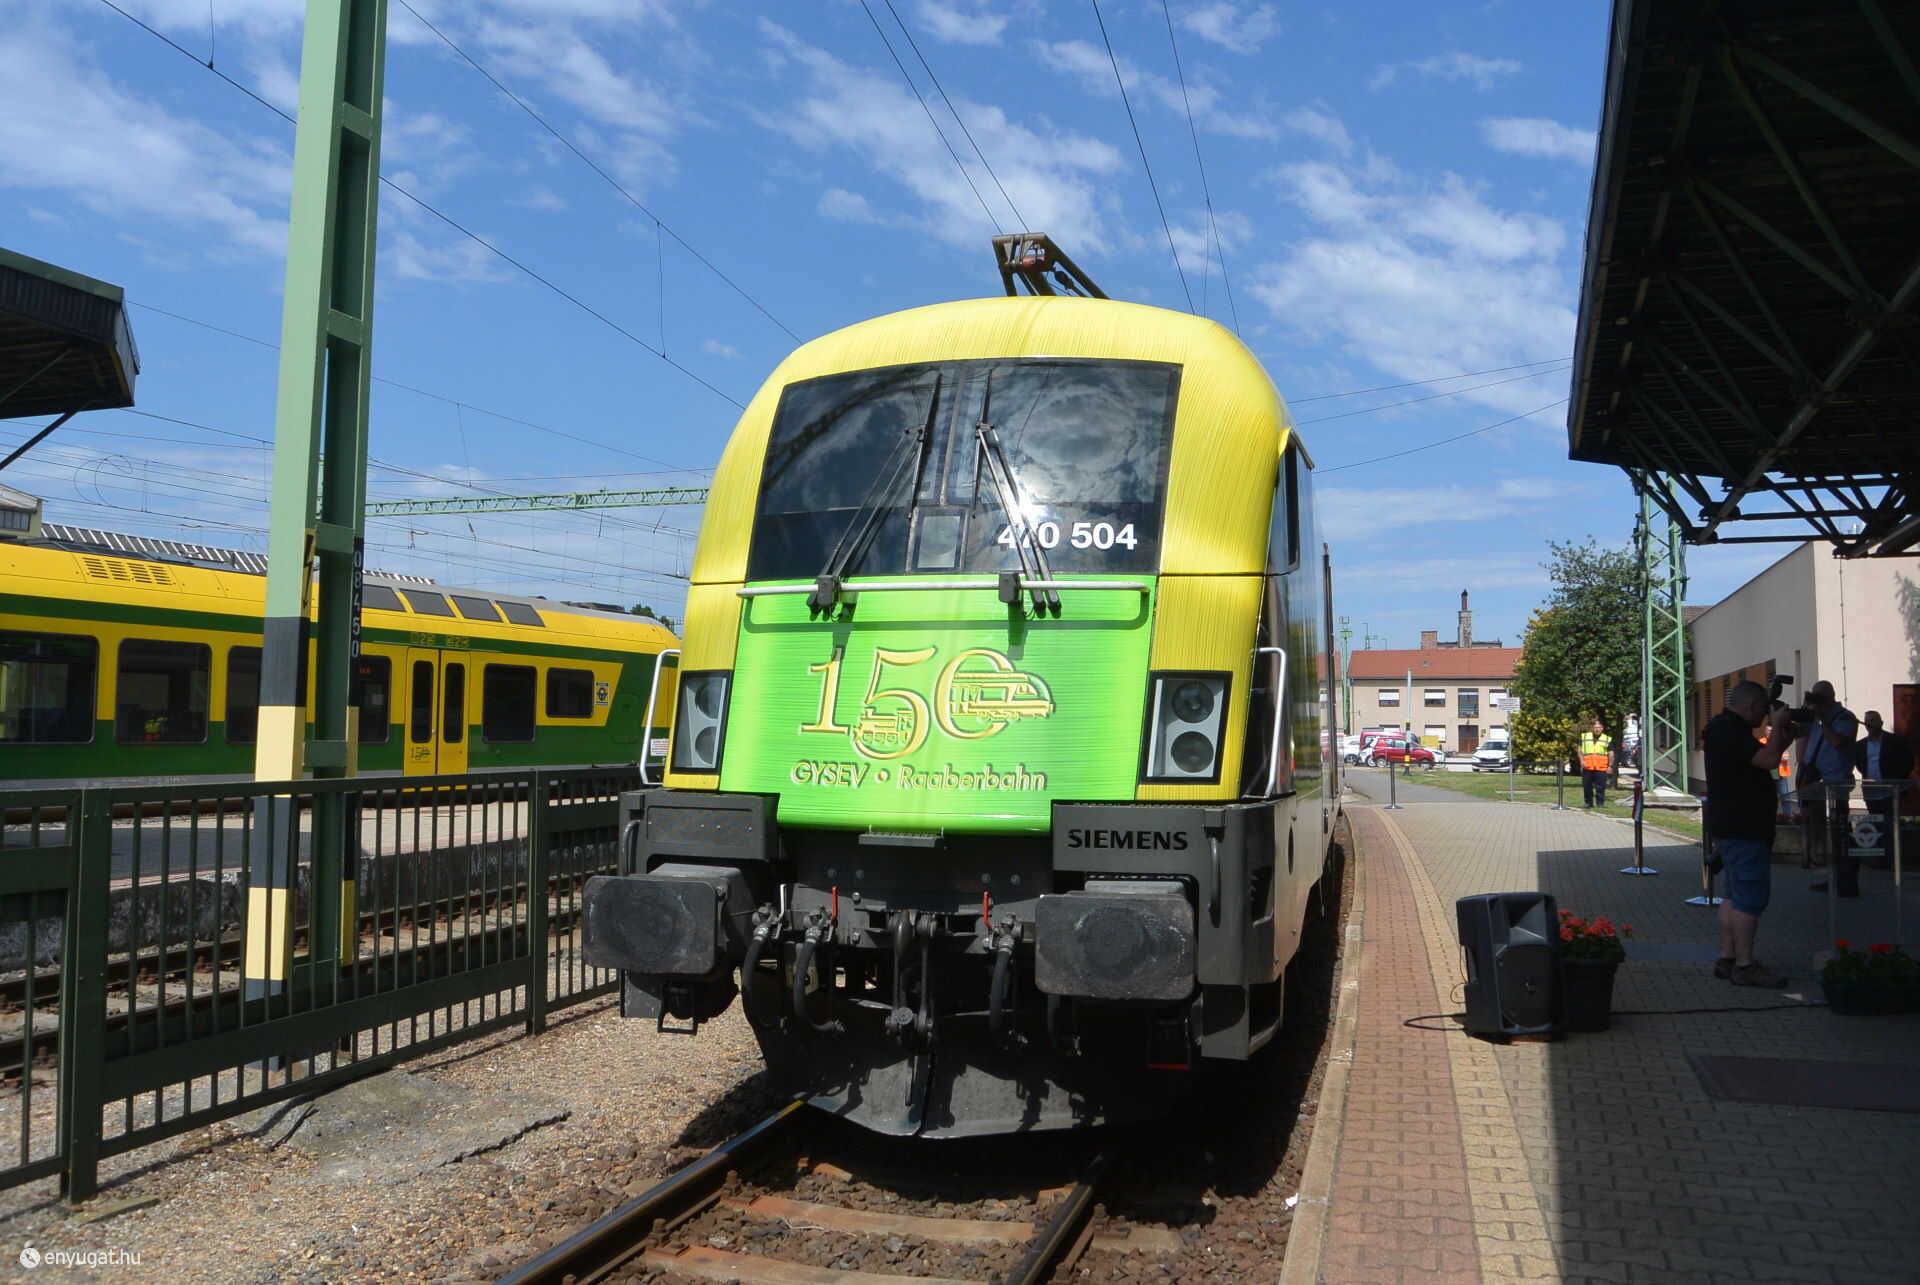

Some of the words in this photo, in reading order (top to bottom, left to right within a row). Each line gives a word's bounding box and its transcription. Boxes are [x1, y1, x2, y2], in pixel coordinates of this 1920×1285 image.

[1071, 522, 1137, 550] 504
[791, 760, 868, 786] GYSEV
[897, 764, 1047, 791] Raaberbahn
[1067, 828, 1188, 851] SIEMENS
